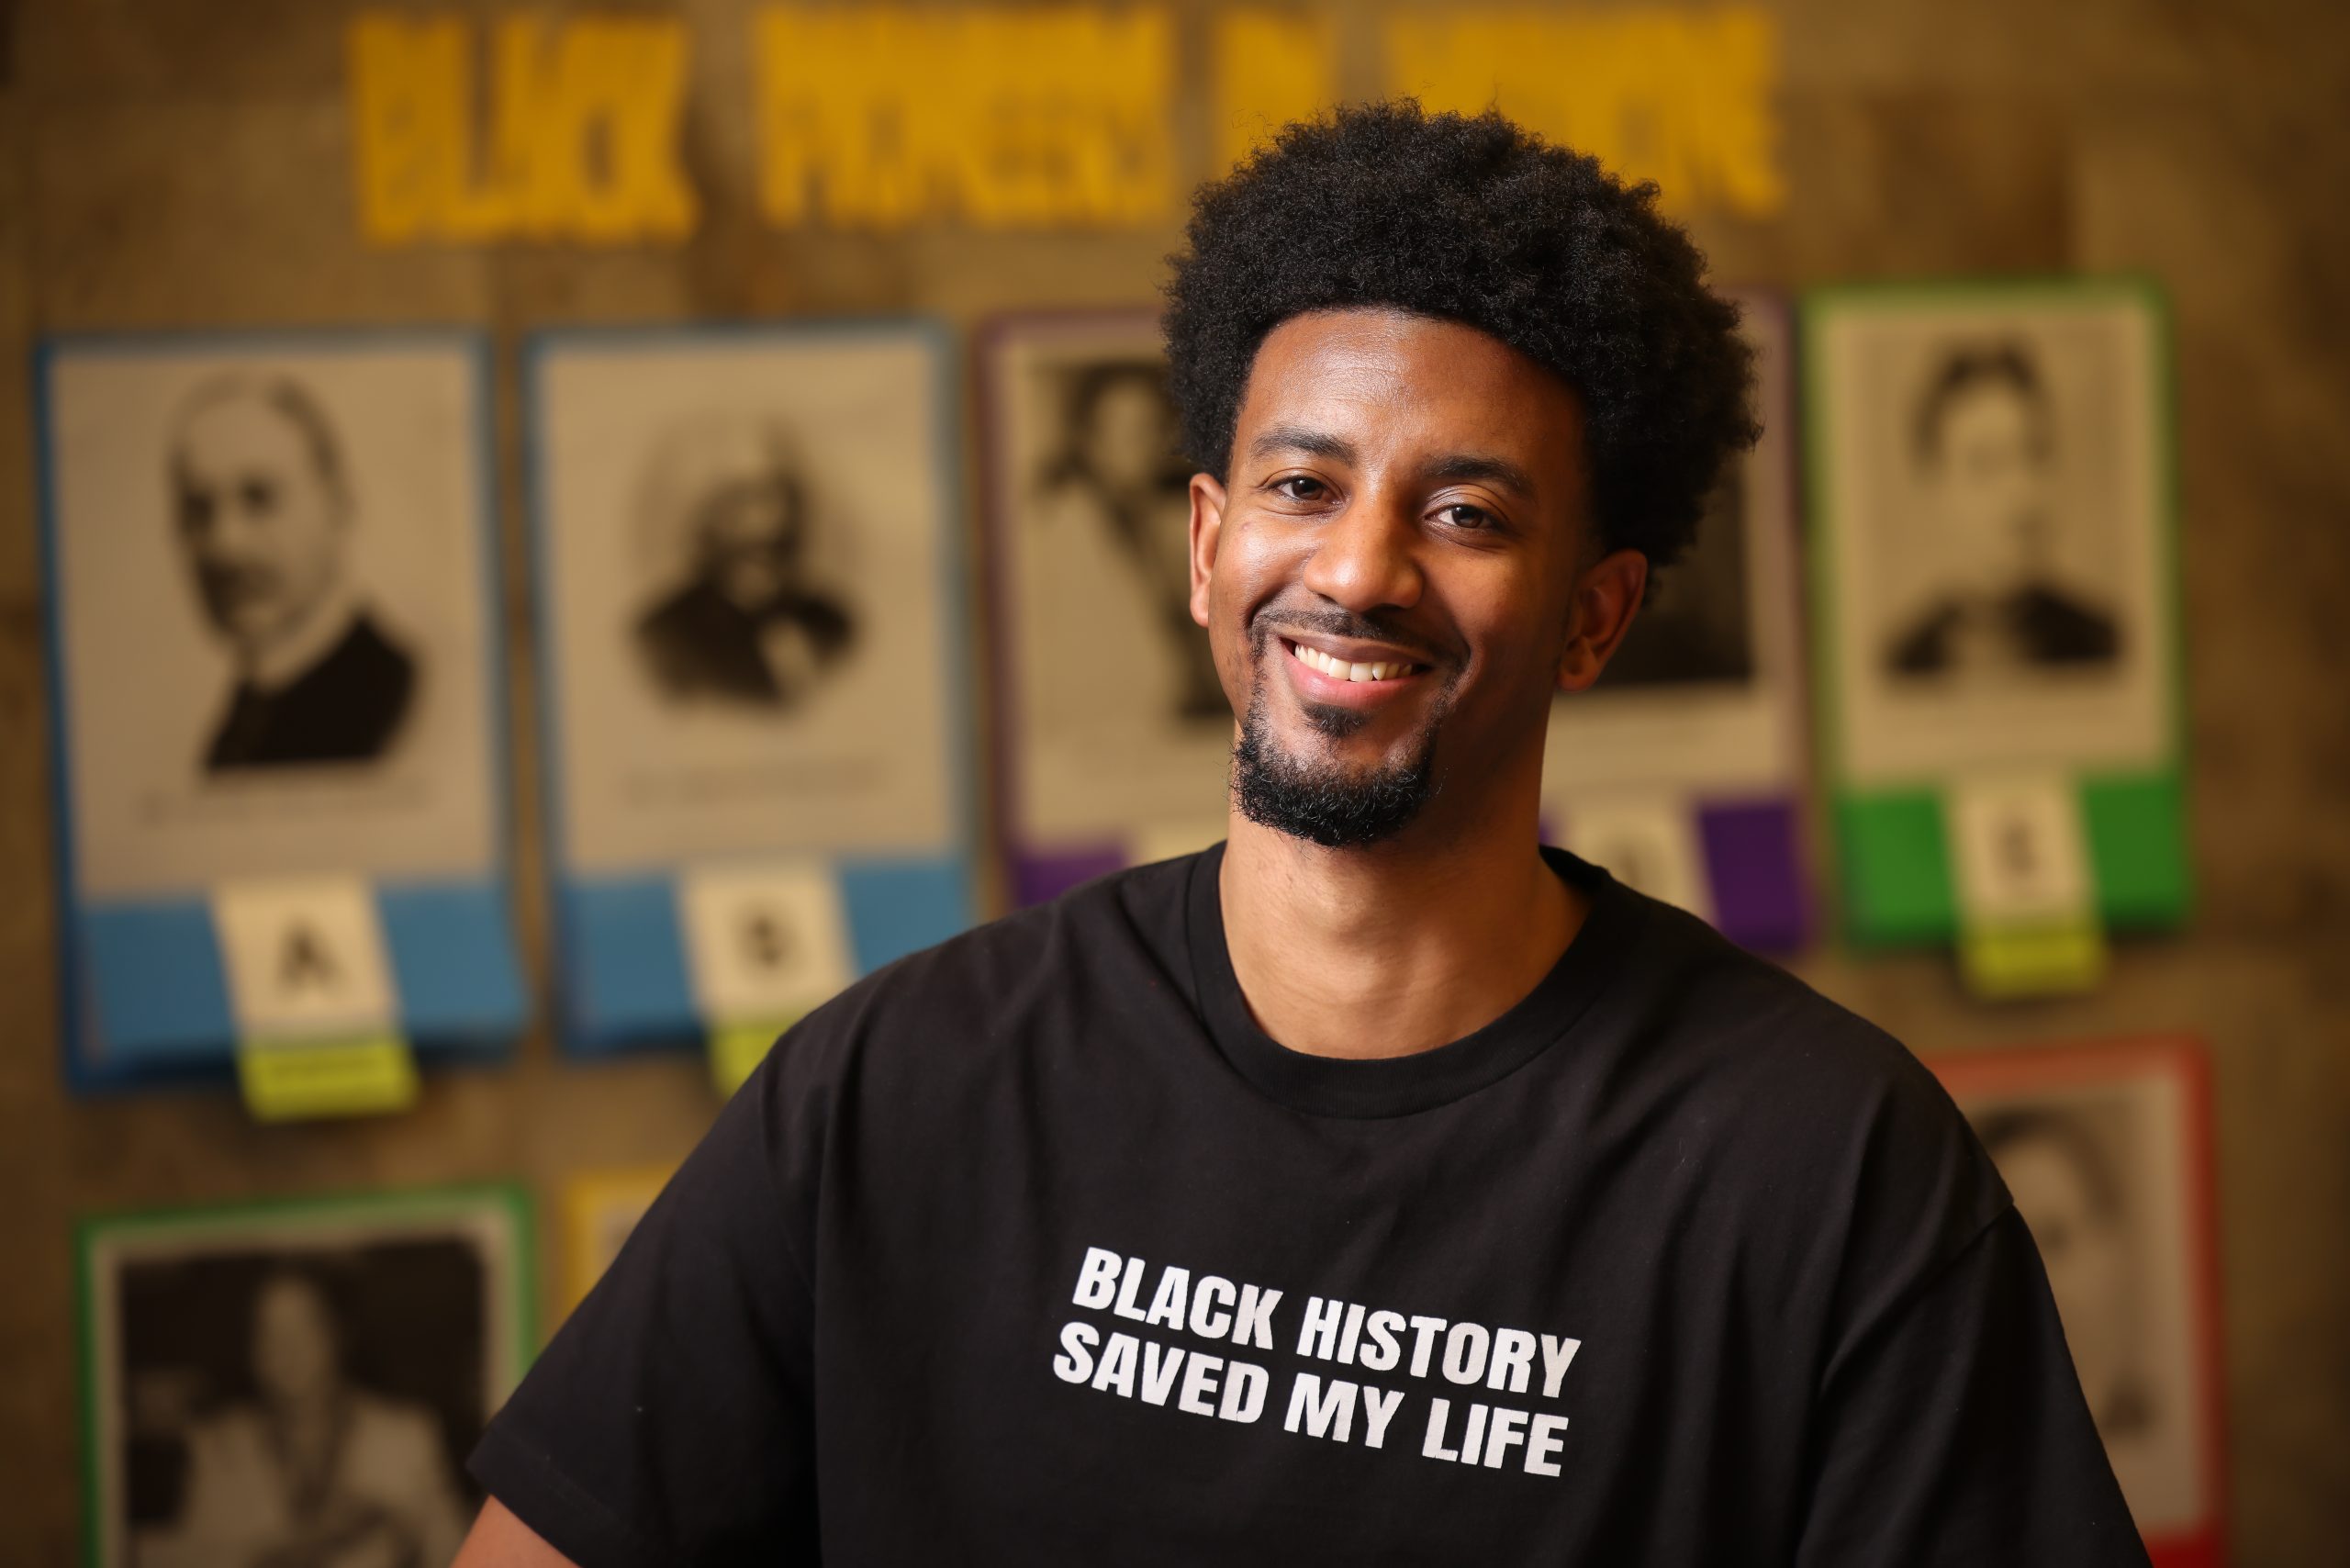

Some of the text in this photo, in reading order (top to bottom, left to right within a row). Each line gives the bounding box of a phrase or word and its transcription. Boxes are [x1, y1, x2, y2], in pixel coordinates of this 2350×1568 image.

[352, 15, 699, 242] BLACK
[278, 913, 347, 999] A
[1072, 1247, 1581, 1397] BLACK HISTORY
[1053, 1322, 1569, 1476] SAVED MY LIFE
